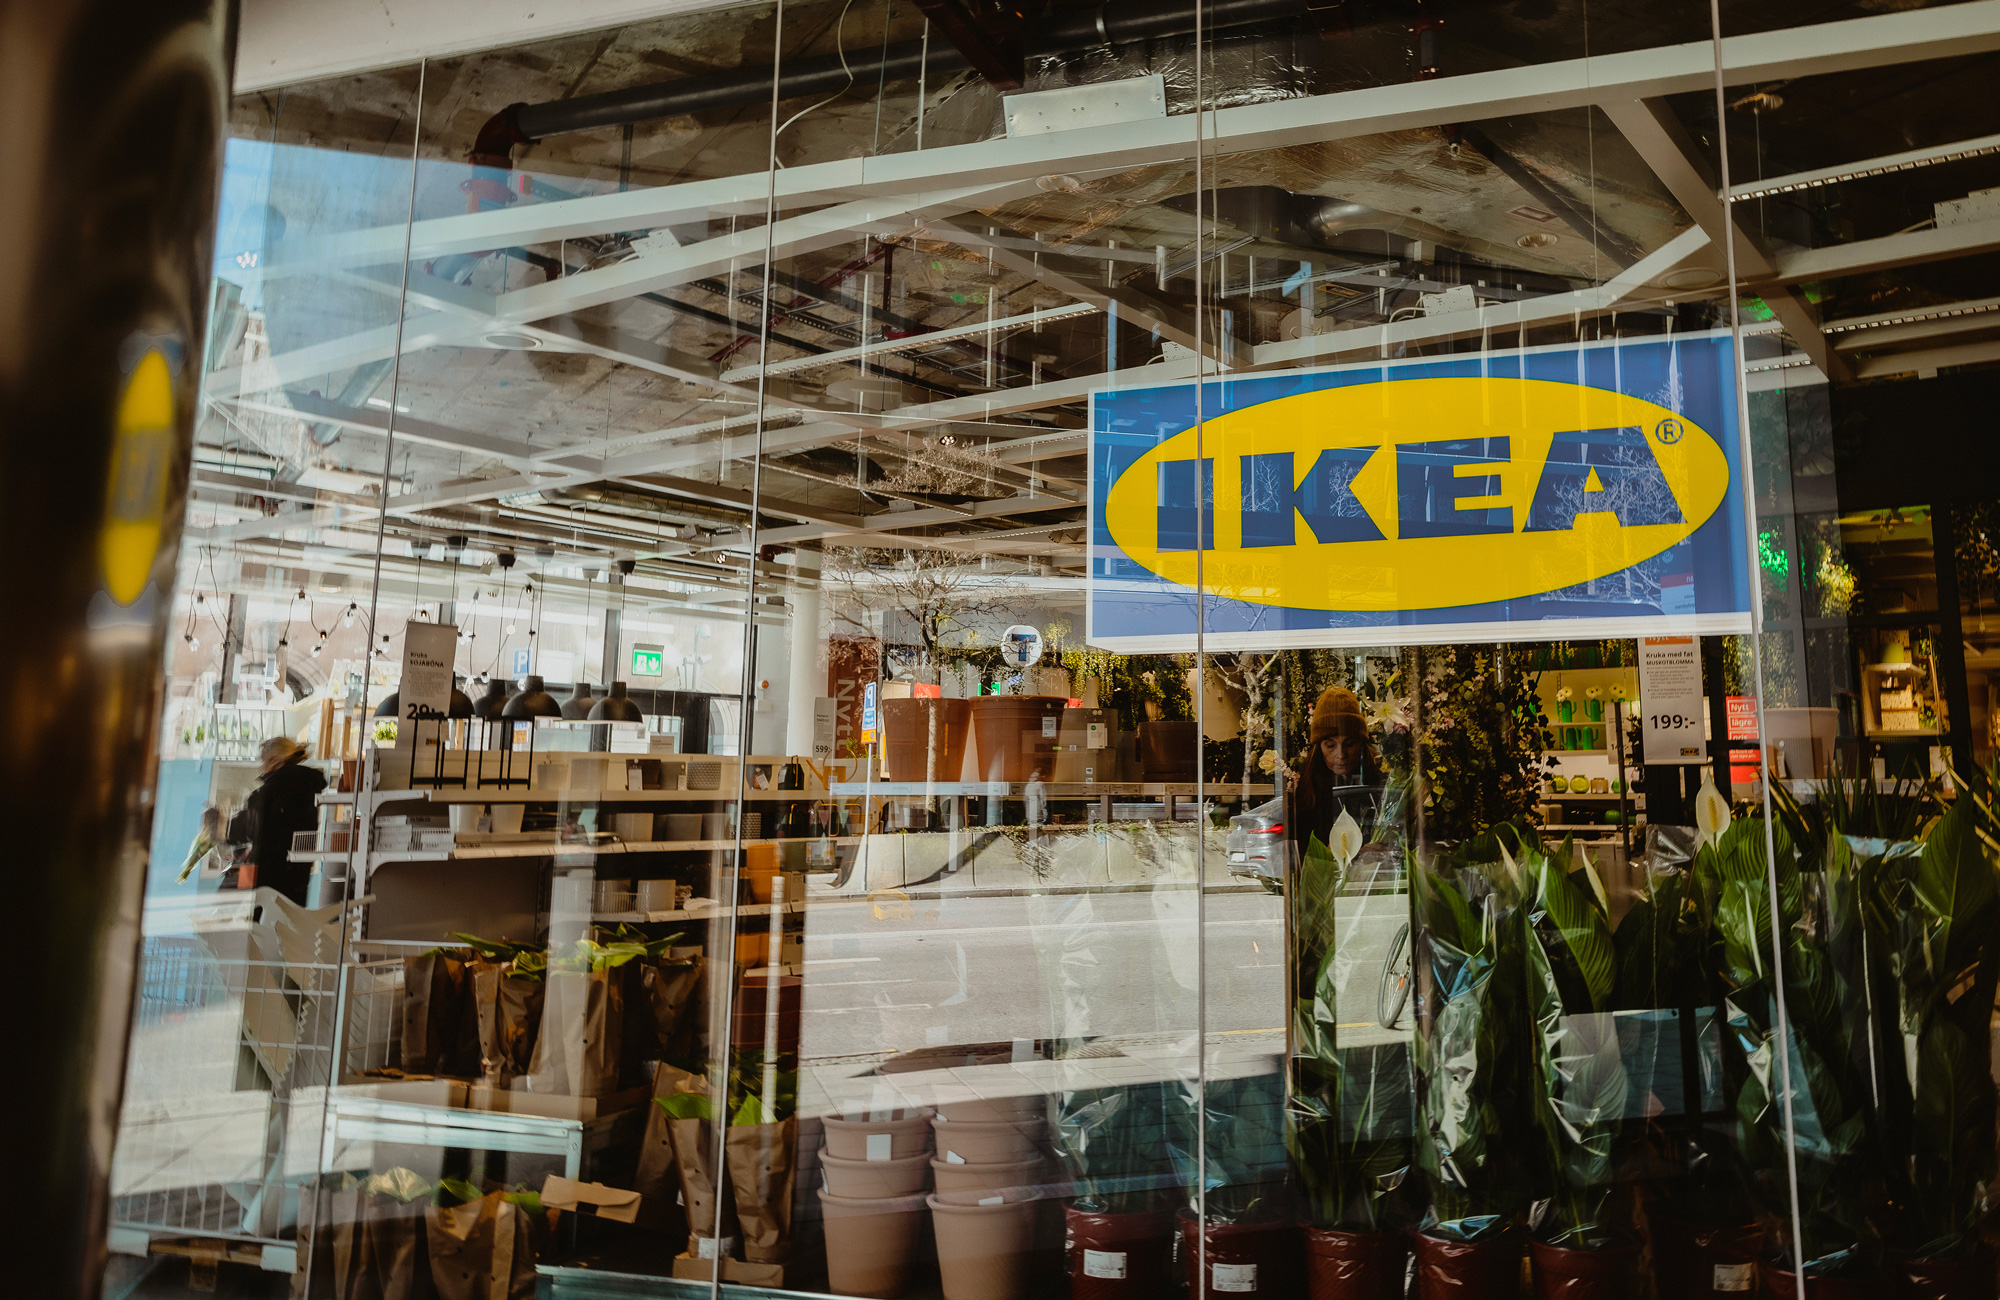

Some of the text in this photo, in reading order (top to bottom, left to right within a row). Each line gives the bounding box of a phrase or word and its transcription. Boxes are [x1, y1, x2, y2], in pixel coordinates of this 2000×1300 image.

[1156, 425, 1688, 553] IKEA
[518, 651, 528, 673] P
[1731, 703, 1750, 712] Nytt
[1650, 714, 1695, 729] 199:-
[1731, 717, 1753, 728] lägre
